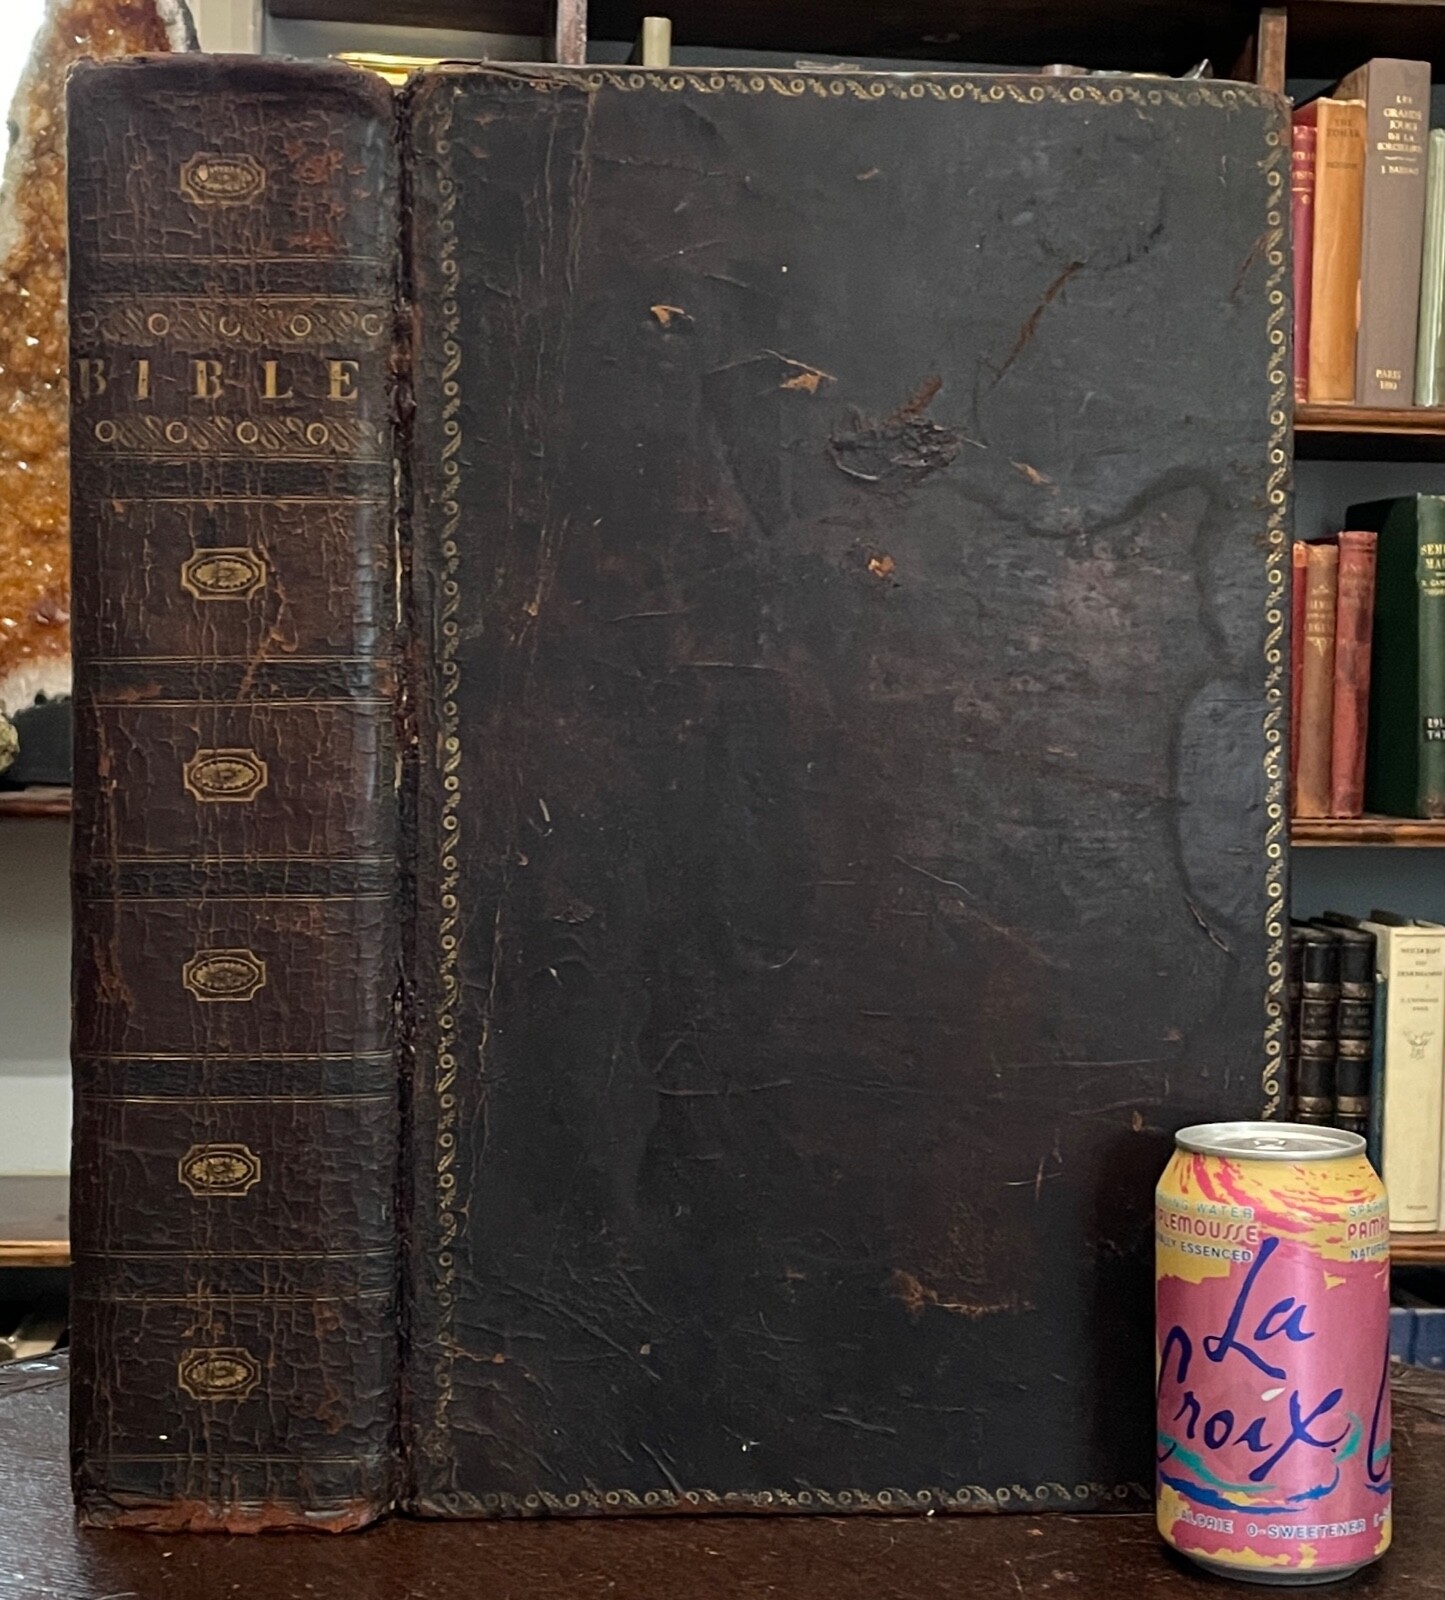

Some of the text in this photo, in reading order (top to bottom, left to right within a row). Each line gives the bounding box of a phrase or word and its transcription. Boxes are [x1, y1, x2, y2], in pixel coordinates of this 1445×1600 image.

[76, 358, 360, 401] BIBLE
[1196, 1203, 1254, 1219] WATER
[1181, 1241, 1252, 1261] ESSENCED
[1203, 1236, 1316, 1380] La
[1157, 1325, 1350, 1482] Croix
